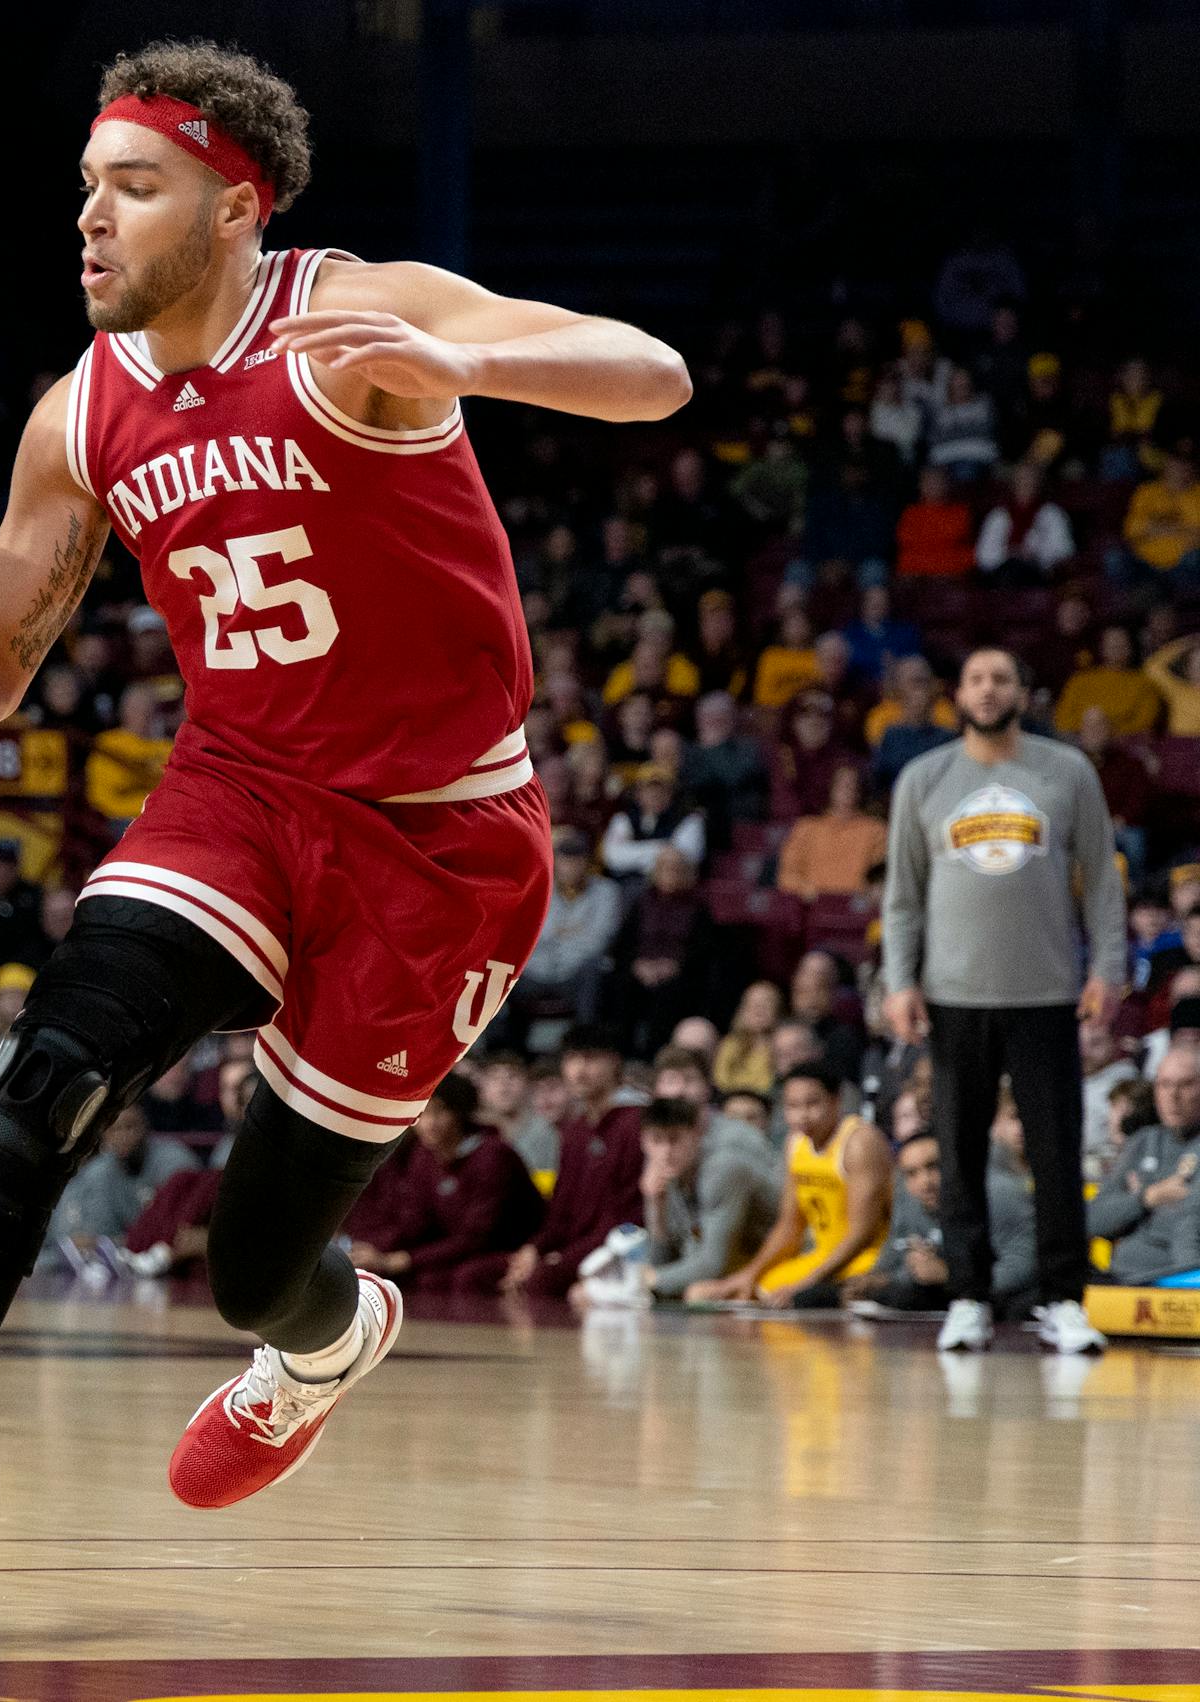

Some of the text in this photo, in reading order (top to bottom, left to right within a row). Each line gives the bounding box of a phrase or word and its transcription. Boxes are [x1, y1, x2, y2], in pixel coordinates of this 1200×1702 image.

[178, 123, 209, 148] adidas
[173, 395, 206, 412] adidas
[168, 525, 340, 669] 25
[377, 1061, 409, 1078] adidas
